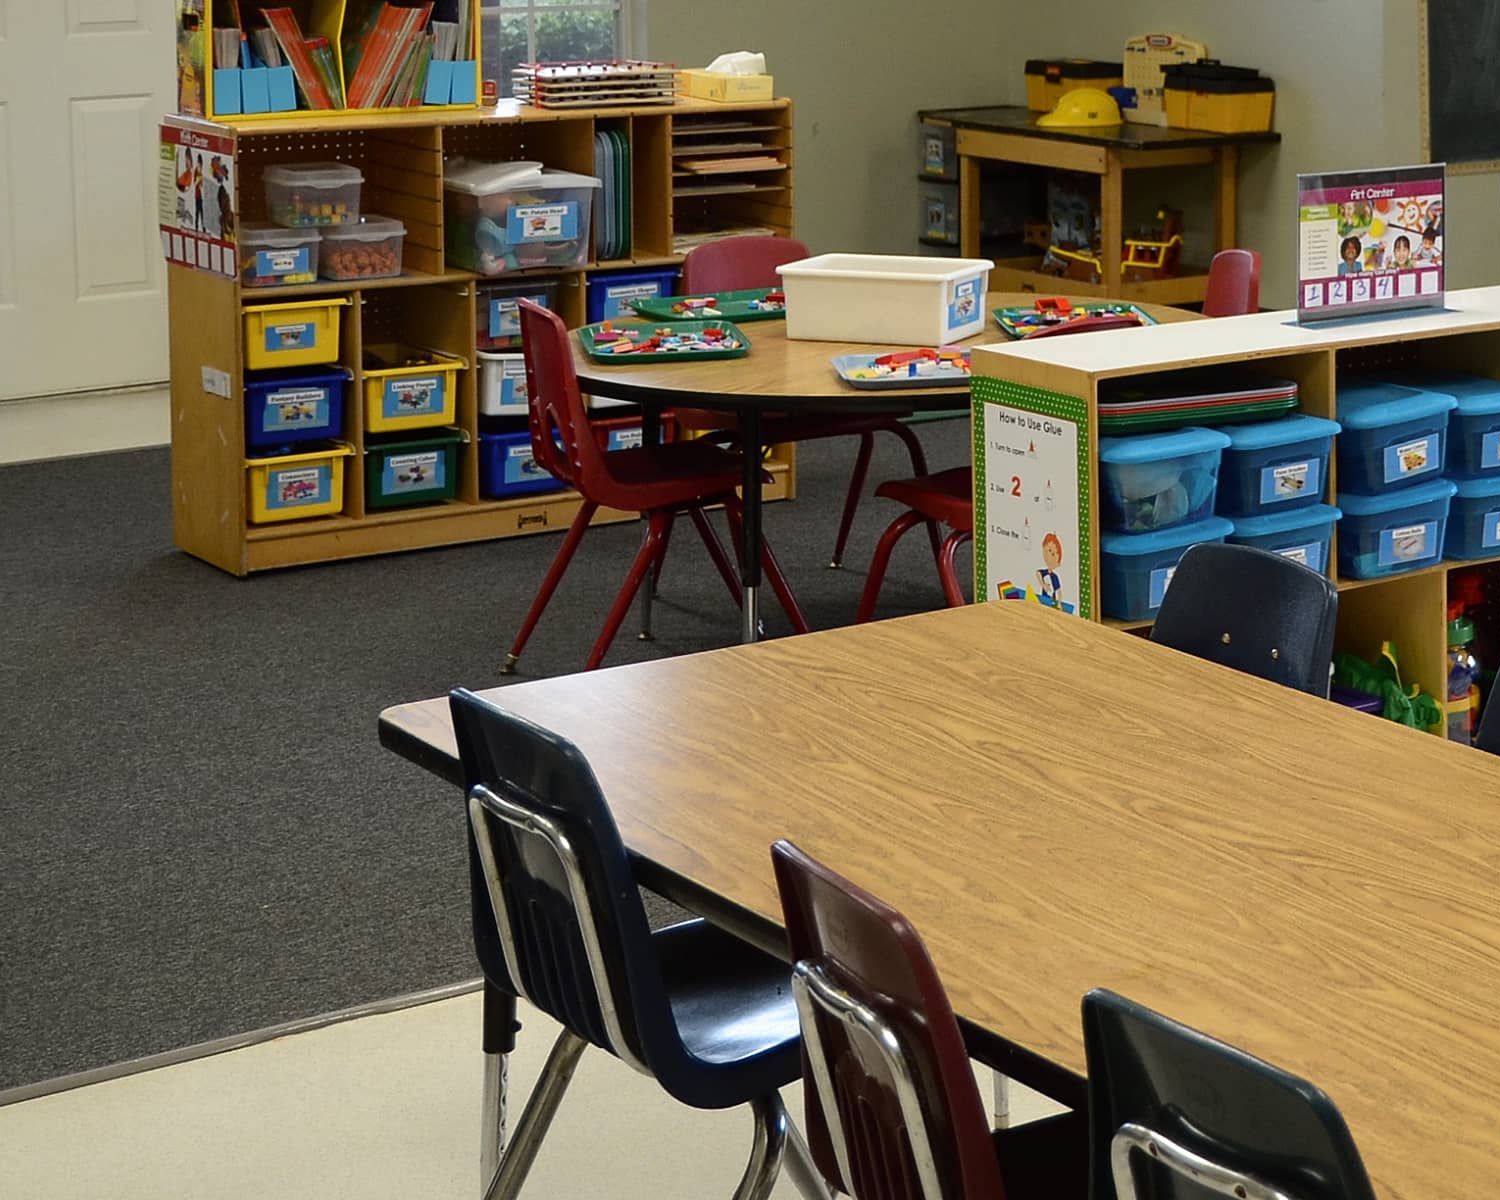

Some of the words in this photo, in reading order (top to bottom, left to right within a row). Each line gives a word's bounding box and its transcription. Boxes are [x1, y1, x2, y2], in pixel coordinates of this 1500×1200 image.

[1350, 189, 1364, 200] Art
[1366, 188, 1395, 199] Center
[1308, 287, 1320, 301] 1
[1333, 283, 1343, 298] 2
[1355, 280, 1366, 296] 3
[1378, 278, 1389, 296] 4
[999, 411, 1015, 425] How
[1018, 416, 1026, 427] to
[1027, 419, 1041, 432] Use
[1043, 421, 1062, 436] Glue
[1011, 475, 1021, 497] 2
